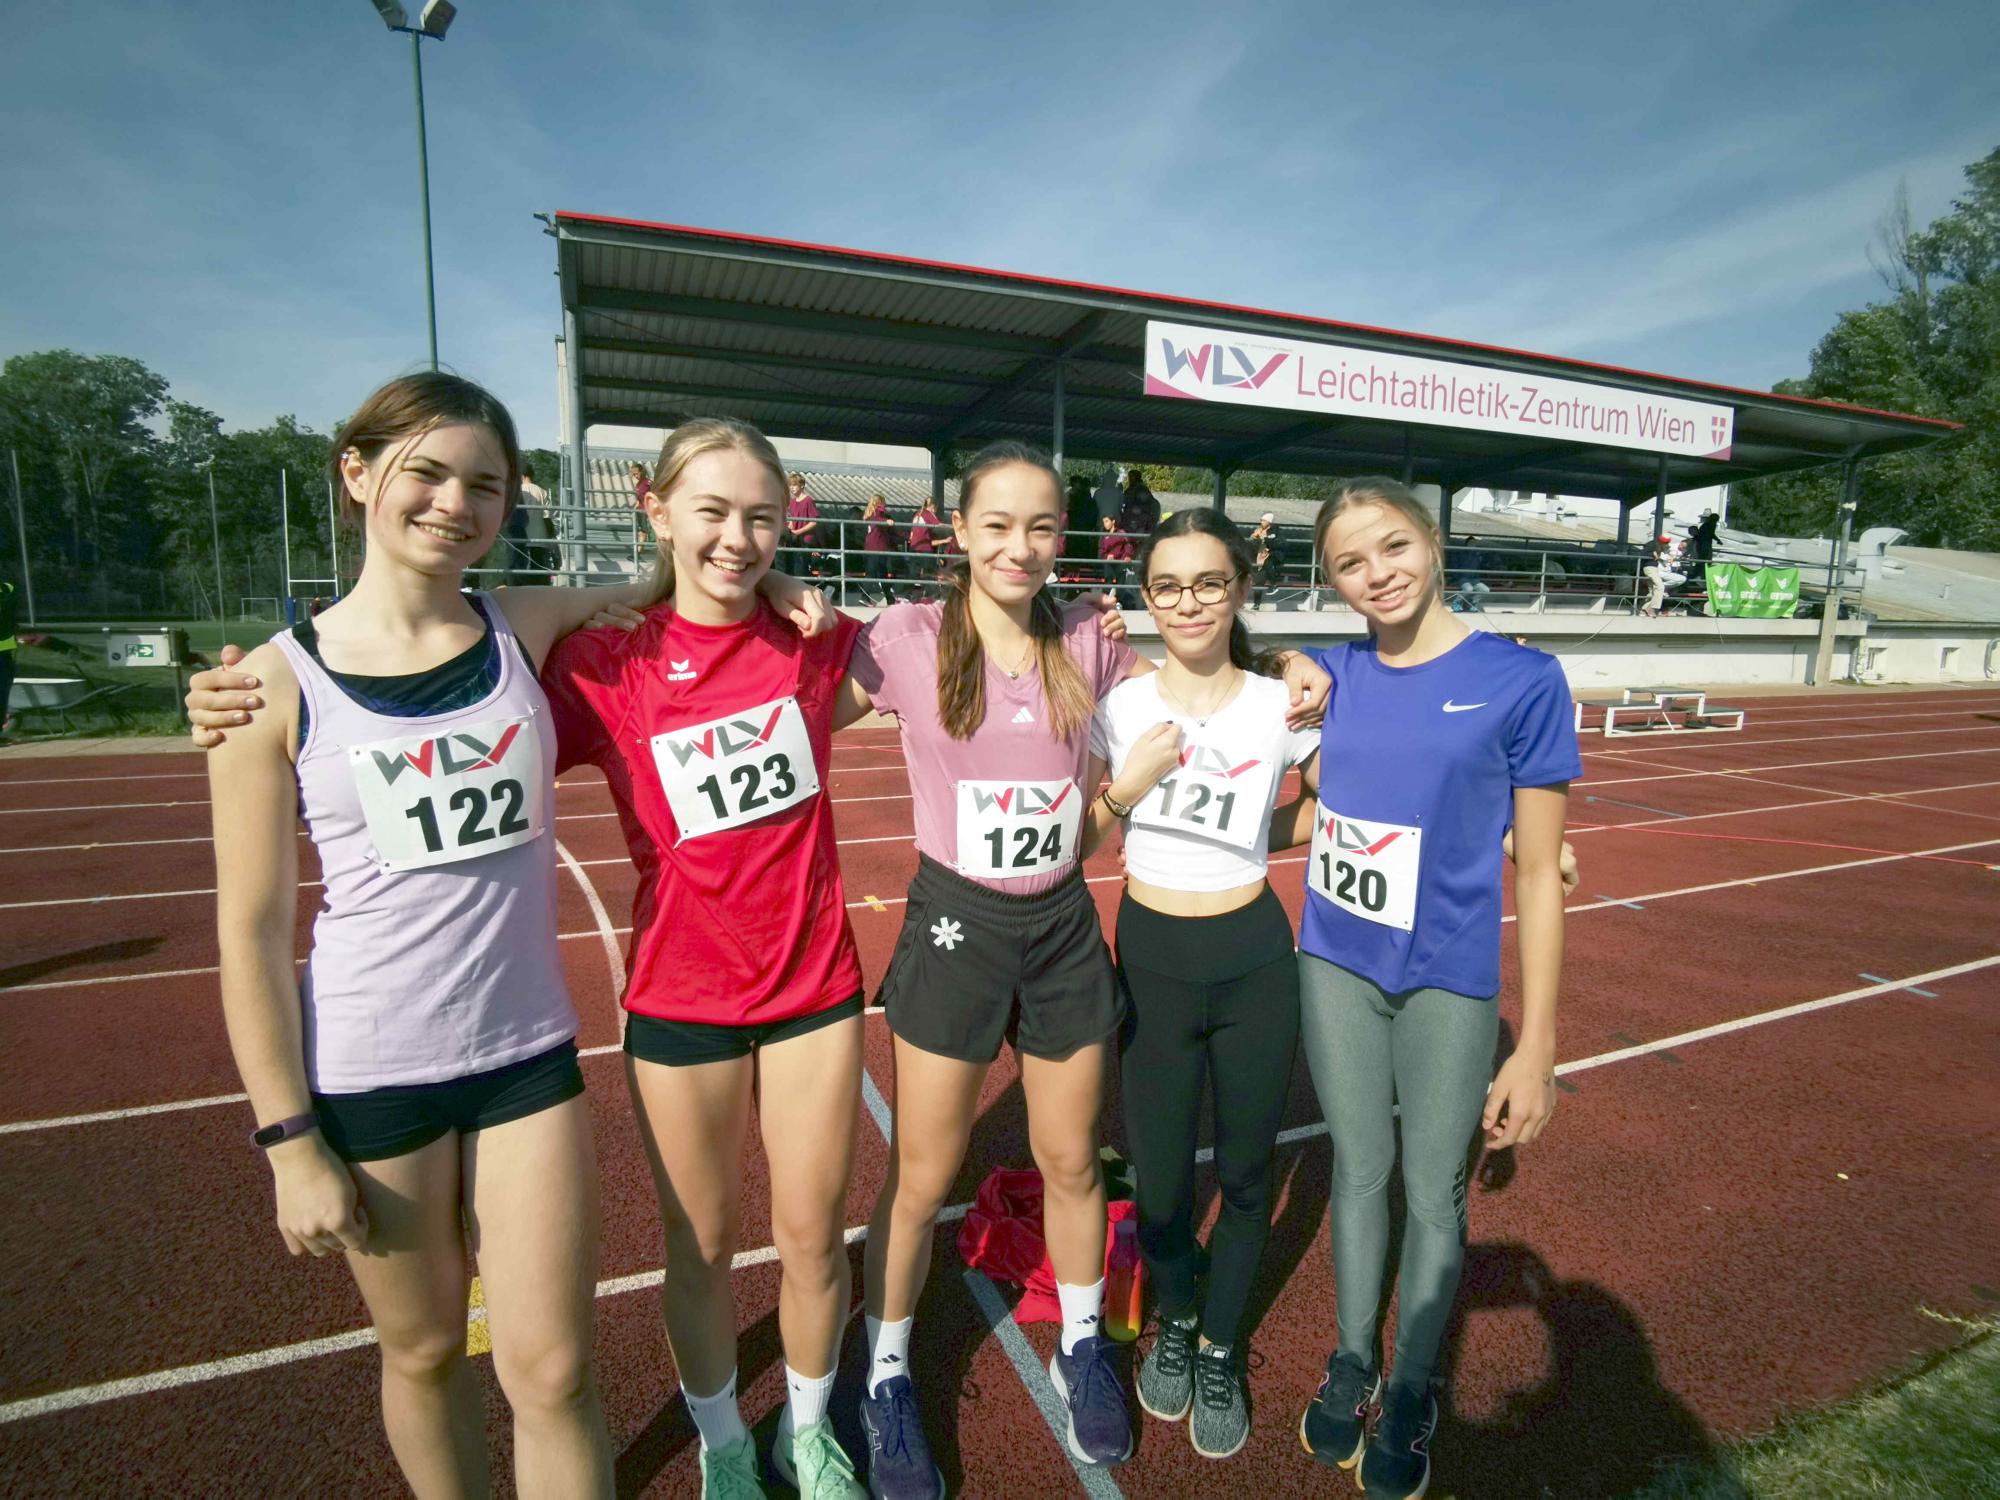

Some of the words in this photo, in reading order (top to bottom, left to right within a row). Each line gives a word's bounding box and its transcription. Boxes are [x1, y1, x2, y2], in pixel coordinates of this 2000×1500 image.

[1162, 338, 1290, 390] WLV
[1297, 356, 1629, 435] Leichtathletik-Zentrum
[1637, 404, 1695, 444] Wien
[370, 723, 522, 787] WLV
[666, 704, 784, 768] WLV
[405, 778, 530, 853] 122
[697, 753, 796, 819] 123
[972, 782, 1073, 816] WLV
[1158, 778, 1236, 832] 121
[984, 823, 1062, 868] 124
[1318, 806, 1404, 857] WLV
[1320, 851, 1387, 912] 120
